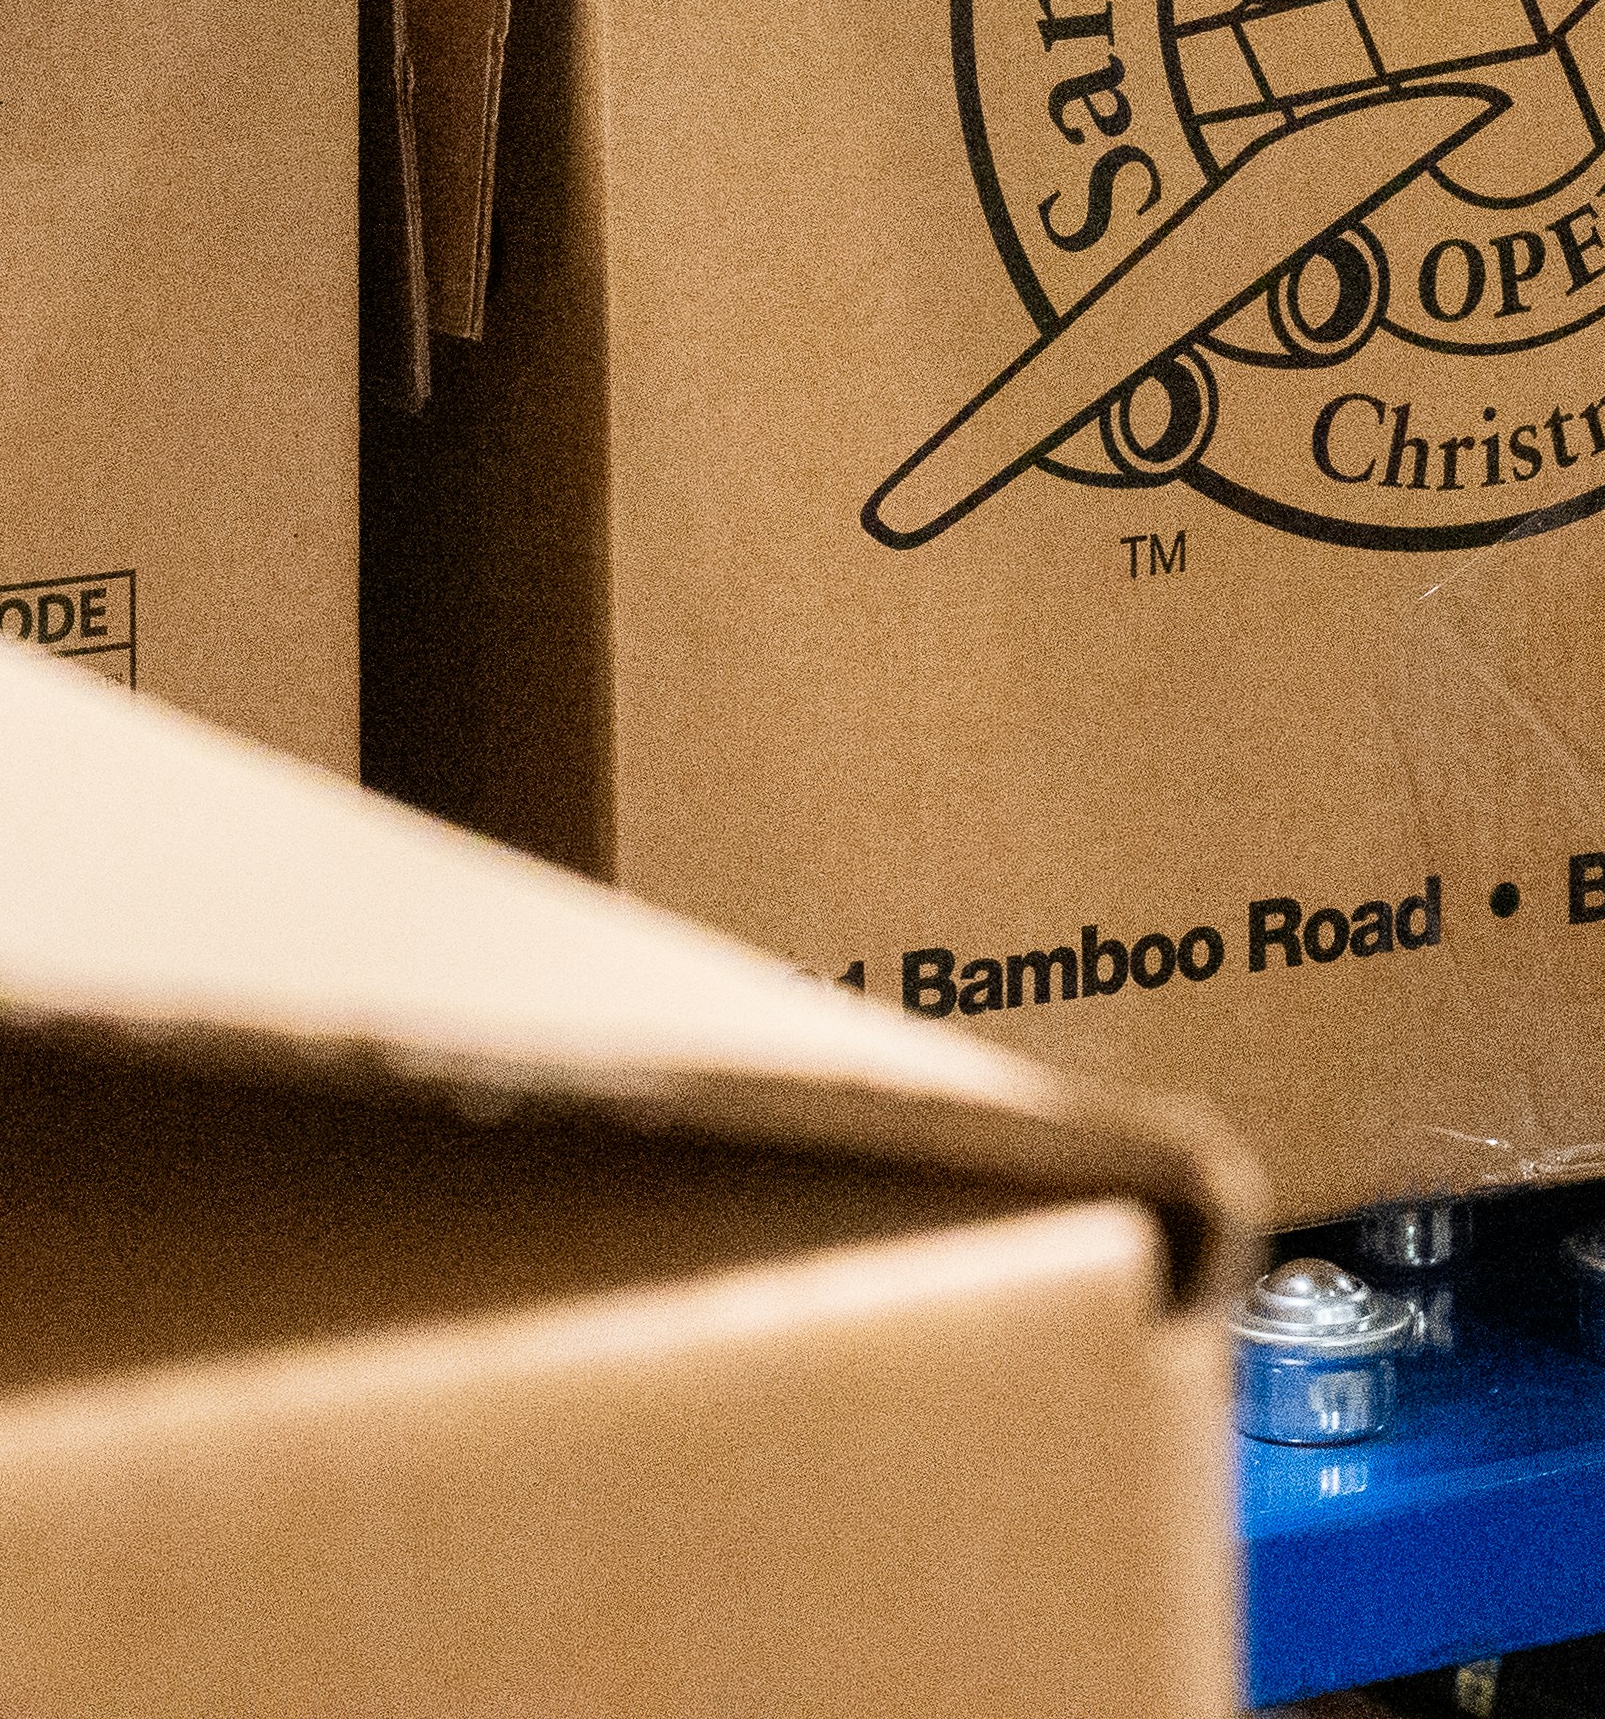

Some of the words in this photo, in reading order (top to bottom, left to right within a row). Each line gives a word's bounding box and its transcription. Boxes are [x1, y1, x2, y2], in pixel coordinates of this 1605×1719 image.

[1119, 530, 1188, 580] TM
[902, 924, 1225, 1018] Bamboo
[1248, 874, 1443, 973] Road
